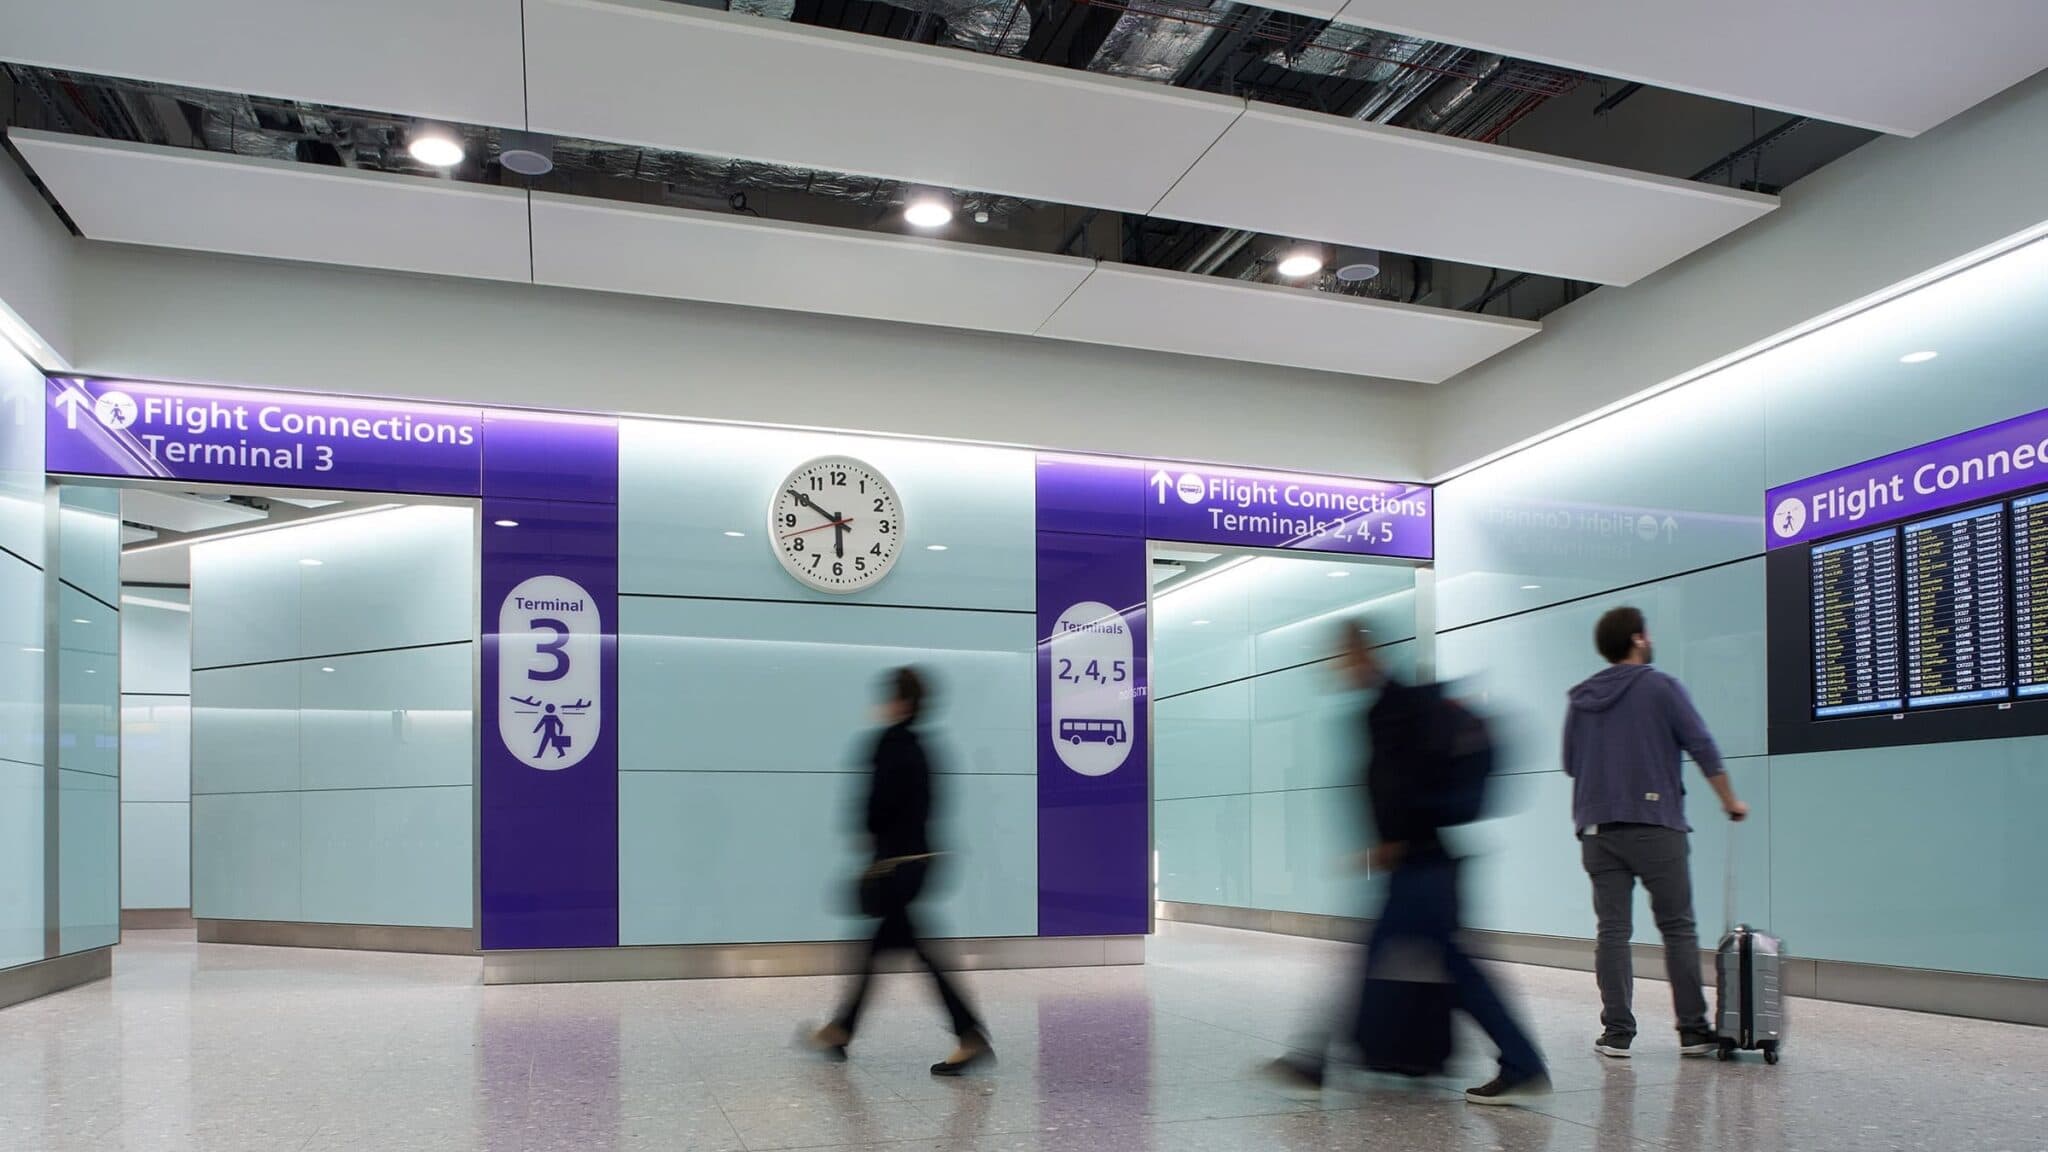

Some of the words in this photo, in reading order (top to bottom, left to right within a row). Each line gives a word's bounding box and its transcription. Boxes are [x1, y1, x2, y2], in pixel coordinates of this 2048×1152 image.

[143, 398, 249, 433] Flight
[257, 405, 474, 446] Connections
[143, 434, 304, 470] Terminal
[315, 445, 335, 472] 3
[810, 476, 823, 491] 11
[830, 471, 847, 486] 12
[859, 480, 865, 494] 1
[1209, 477, 1278, 508] Flight
[1284, 484, 1426, 517] Connections
[1813, 475, 1904, 523] Flight
[873, 498, 884, 512] 2
[785, 513, 796, 527] 9
[879, 520, 890, 534] 3
[1208, 507, 1327, 538] Terminals
[793, 537, 804, 551] 8
[870, 542, 881, 556] 4
[811, 553, 821, 568] 7
[855, 556, 865, 571] 5
[832, 562, 843, 576] 6
[515, 597, 583, 612] Terminal
[1061, 620, 1123, 635] Terminals
[528, 618, 570, 681] 3
